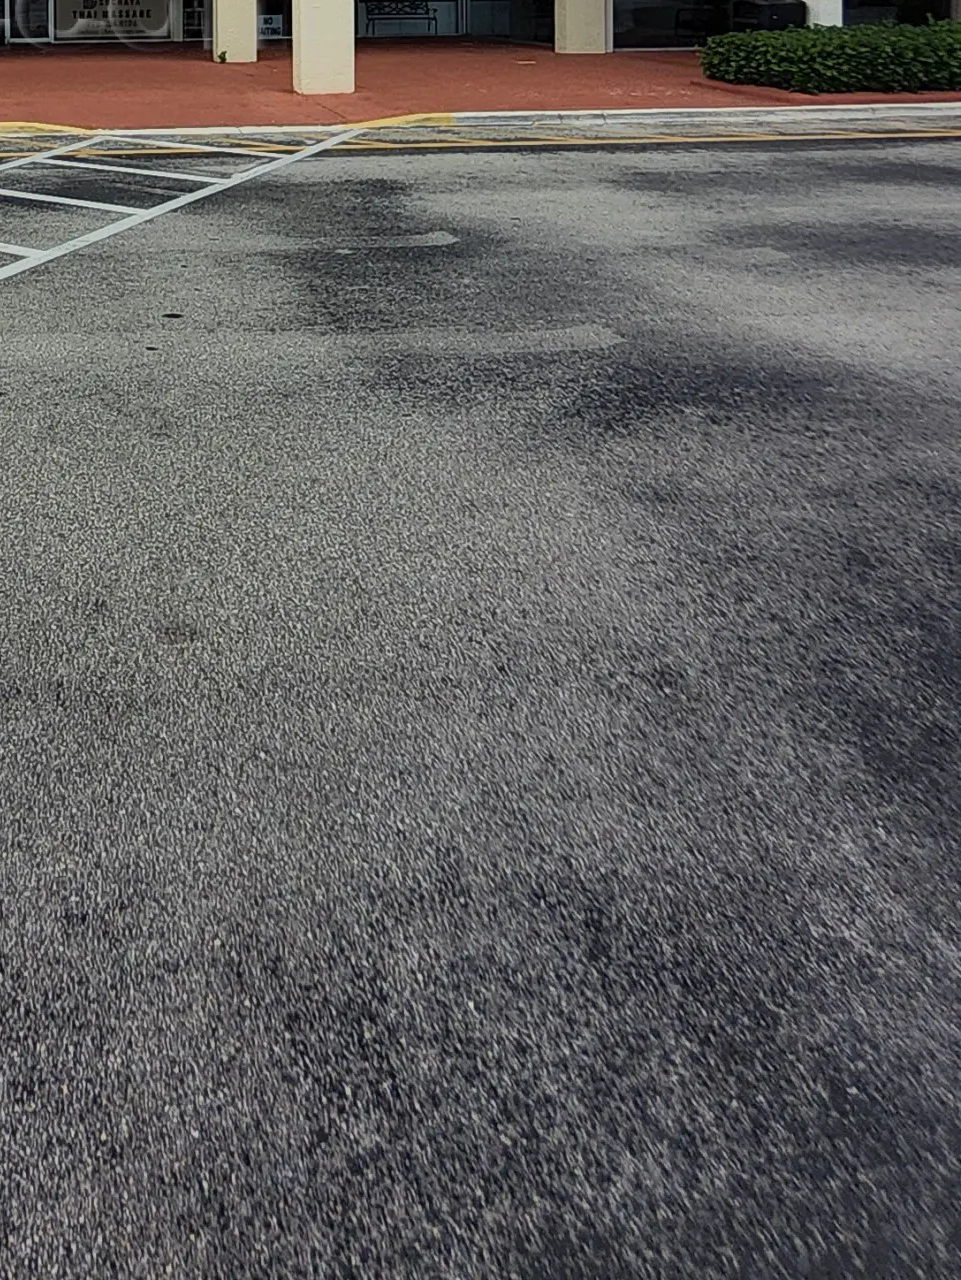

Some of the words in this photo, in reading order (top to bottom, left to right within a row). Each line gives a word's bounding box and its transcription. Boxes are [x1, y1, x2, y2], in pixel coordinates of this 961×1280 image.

[72, 10, 98, 19] THAI
[102, 9, 152, 19] MASSAGE
[263, 16, 273, 26] NO
